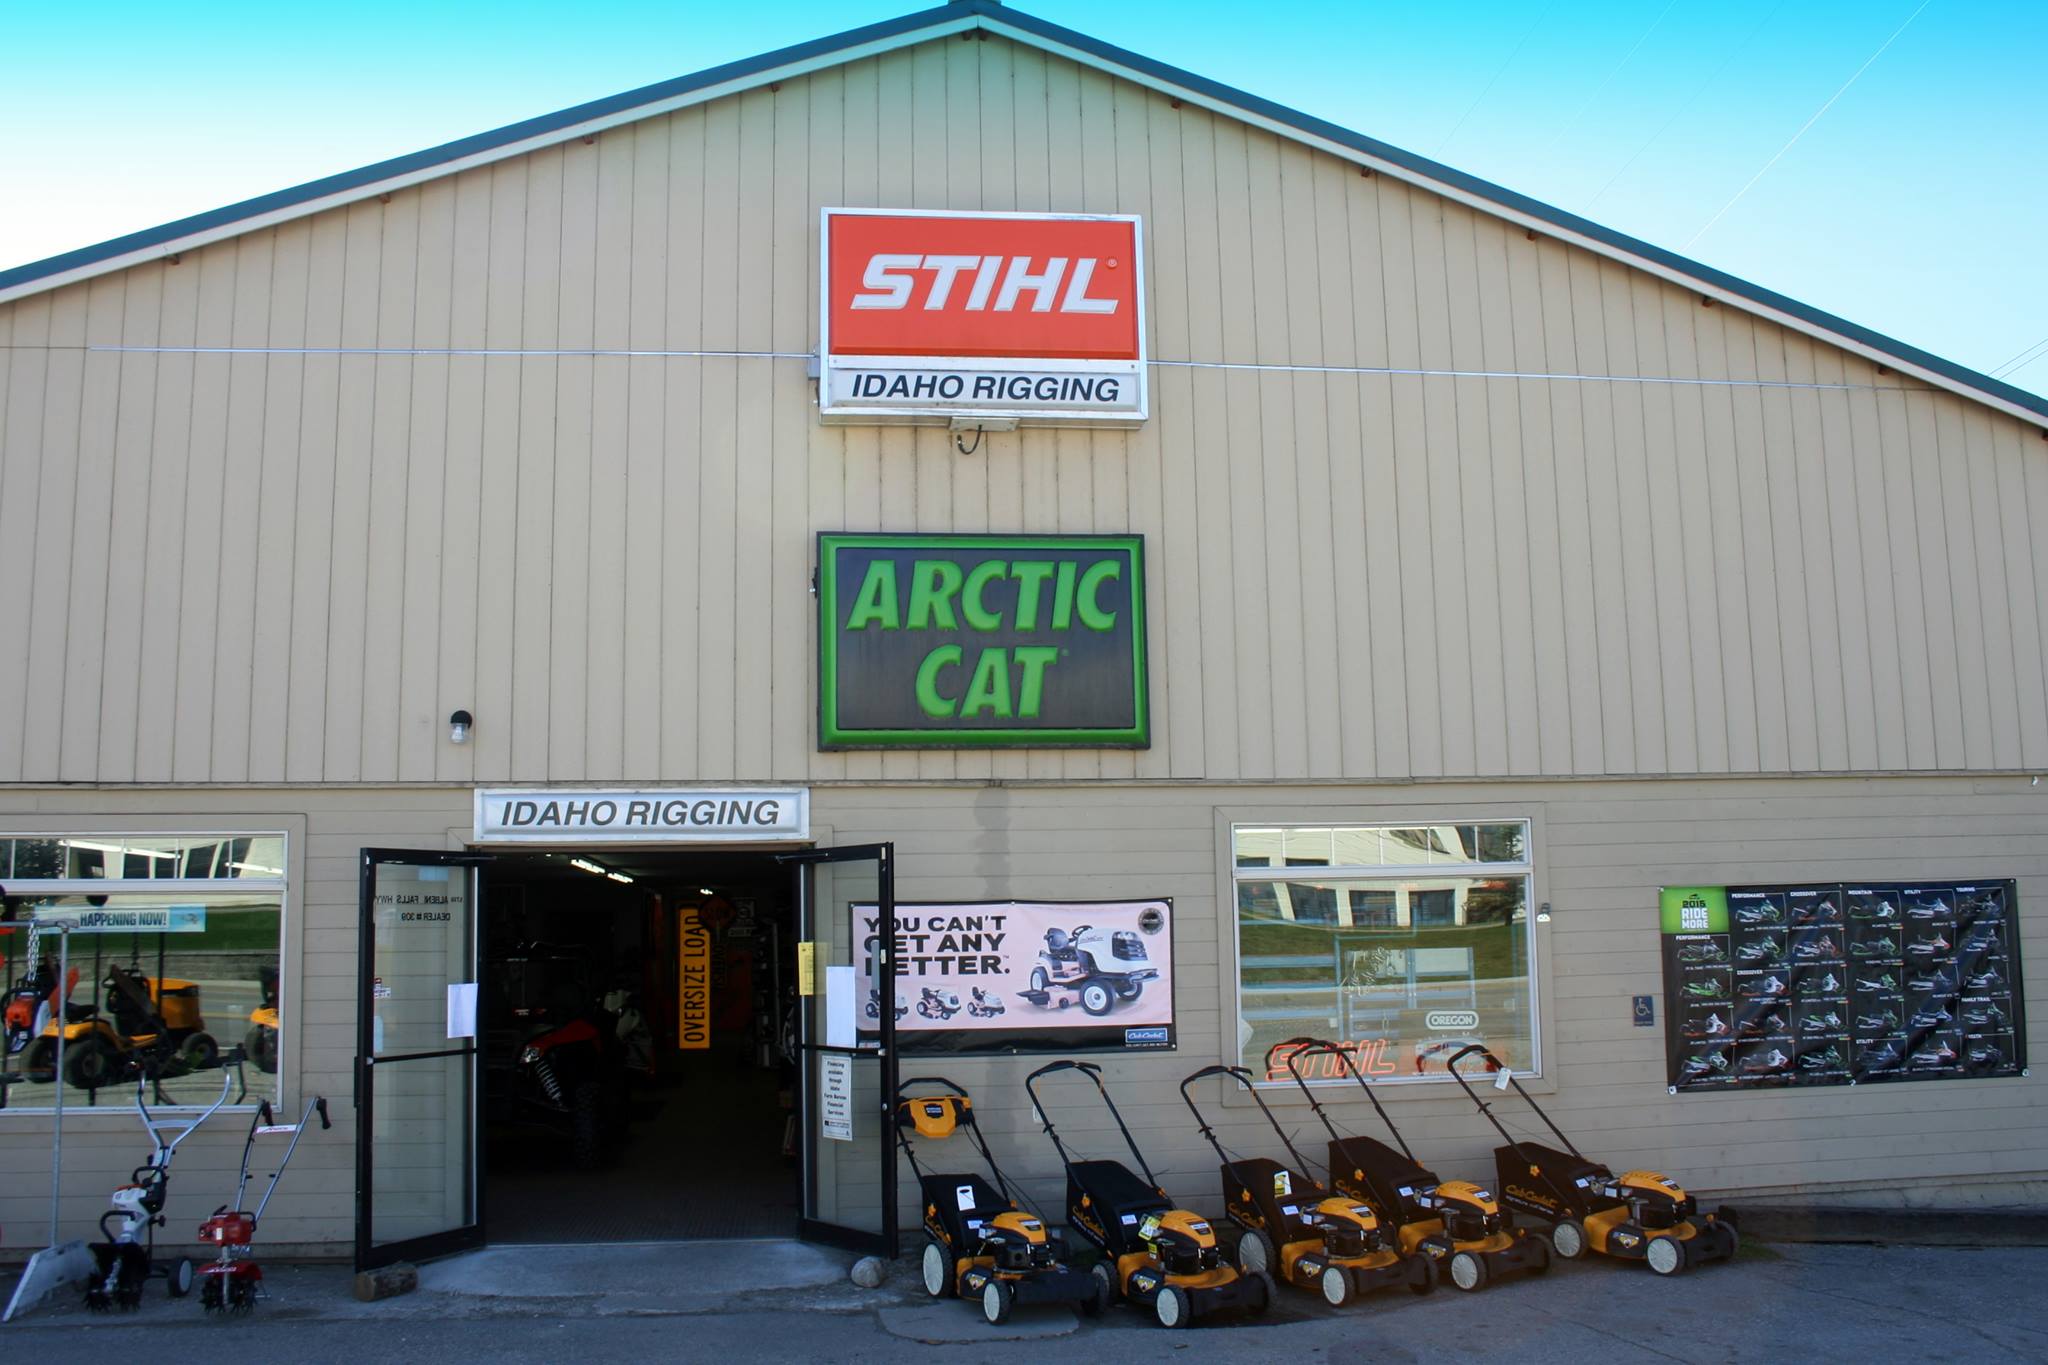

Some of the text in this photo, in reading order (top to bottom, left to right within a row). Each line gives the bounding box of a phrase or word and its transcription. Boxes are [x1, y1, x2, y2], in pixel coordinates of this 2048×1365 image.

[850, 253, 1119, 314] STIHL
[852, 374, 1120, 402] IDAHO RIGGING
[846, 559, 1121, 632] ARCTIC
[915, 644, 1058, 719] CAT
[501, 800, 780, 826] IDAHO RIGGING
[80, 912, 167, 927] HAPPENING NOW!
[864, 915, 1007, 932] YU CAN'T
[1681, 908, 1708, 919] RIDE
[1681, 919, 1709, 929] MORE
[937, 933, 1006, 952] ANY
[865, 955, 1010, 976] ETTER.
[684, 915, 705, 1042] OVERSIZE LOAD
[1431, 1015, 1473, 1025] OREGON
